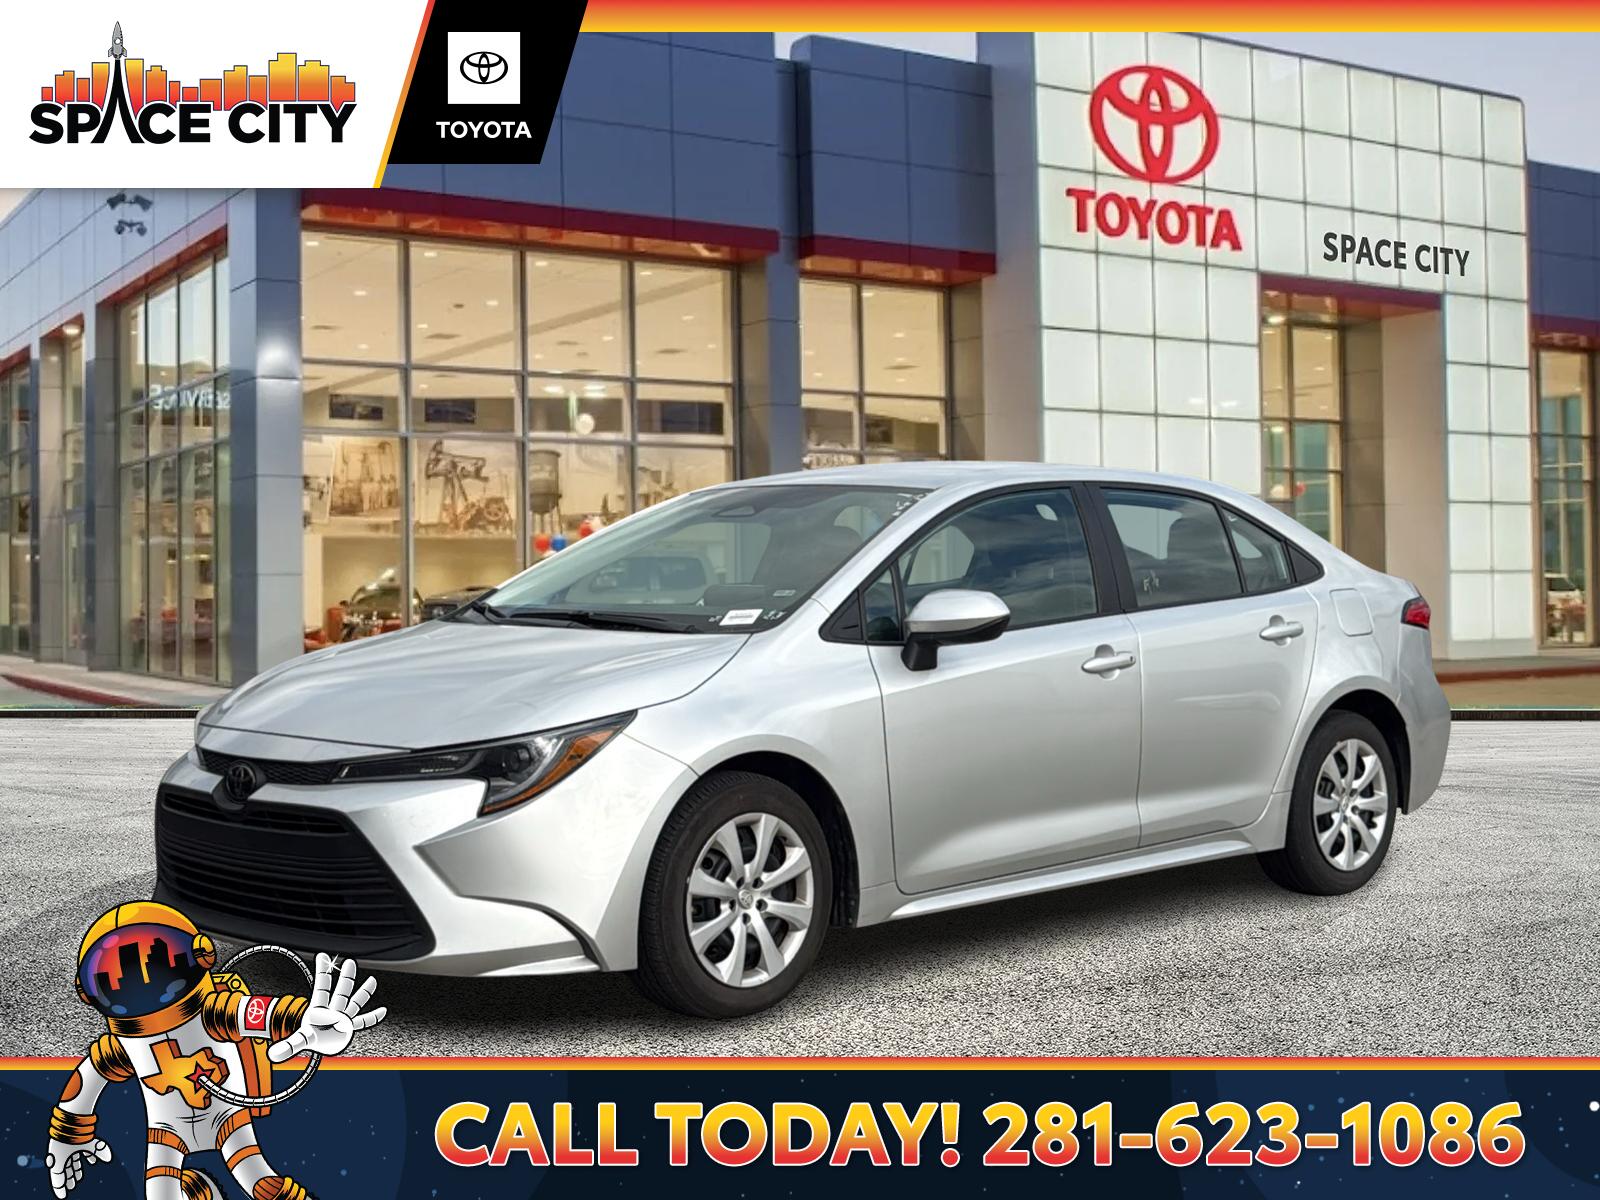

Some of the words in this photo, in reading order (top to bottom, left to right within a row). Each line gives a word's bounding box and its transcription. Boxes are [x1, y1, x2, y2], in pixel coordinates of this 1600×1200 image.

[1066, 187, 1242, 252] TOYOTA
[1323, 232, 1407, 270] SPACE
[1415, 244, 1470, 277] CITY
